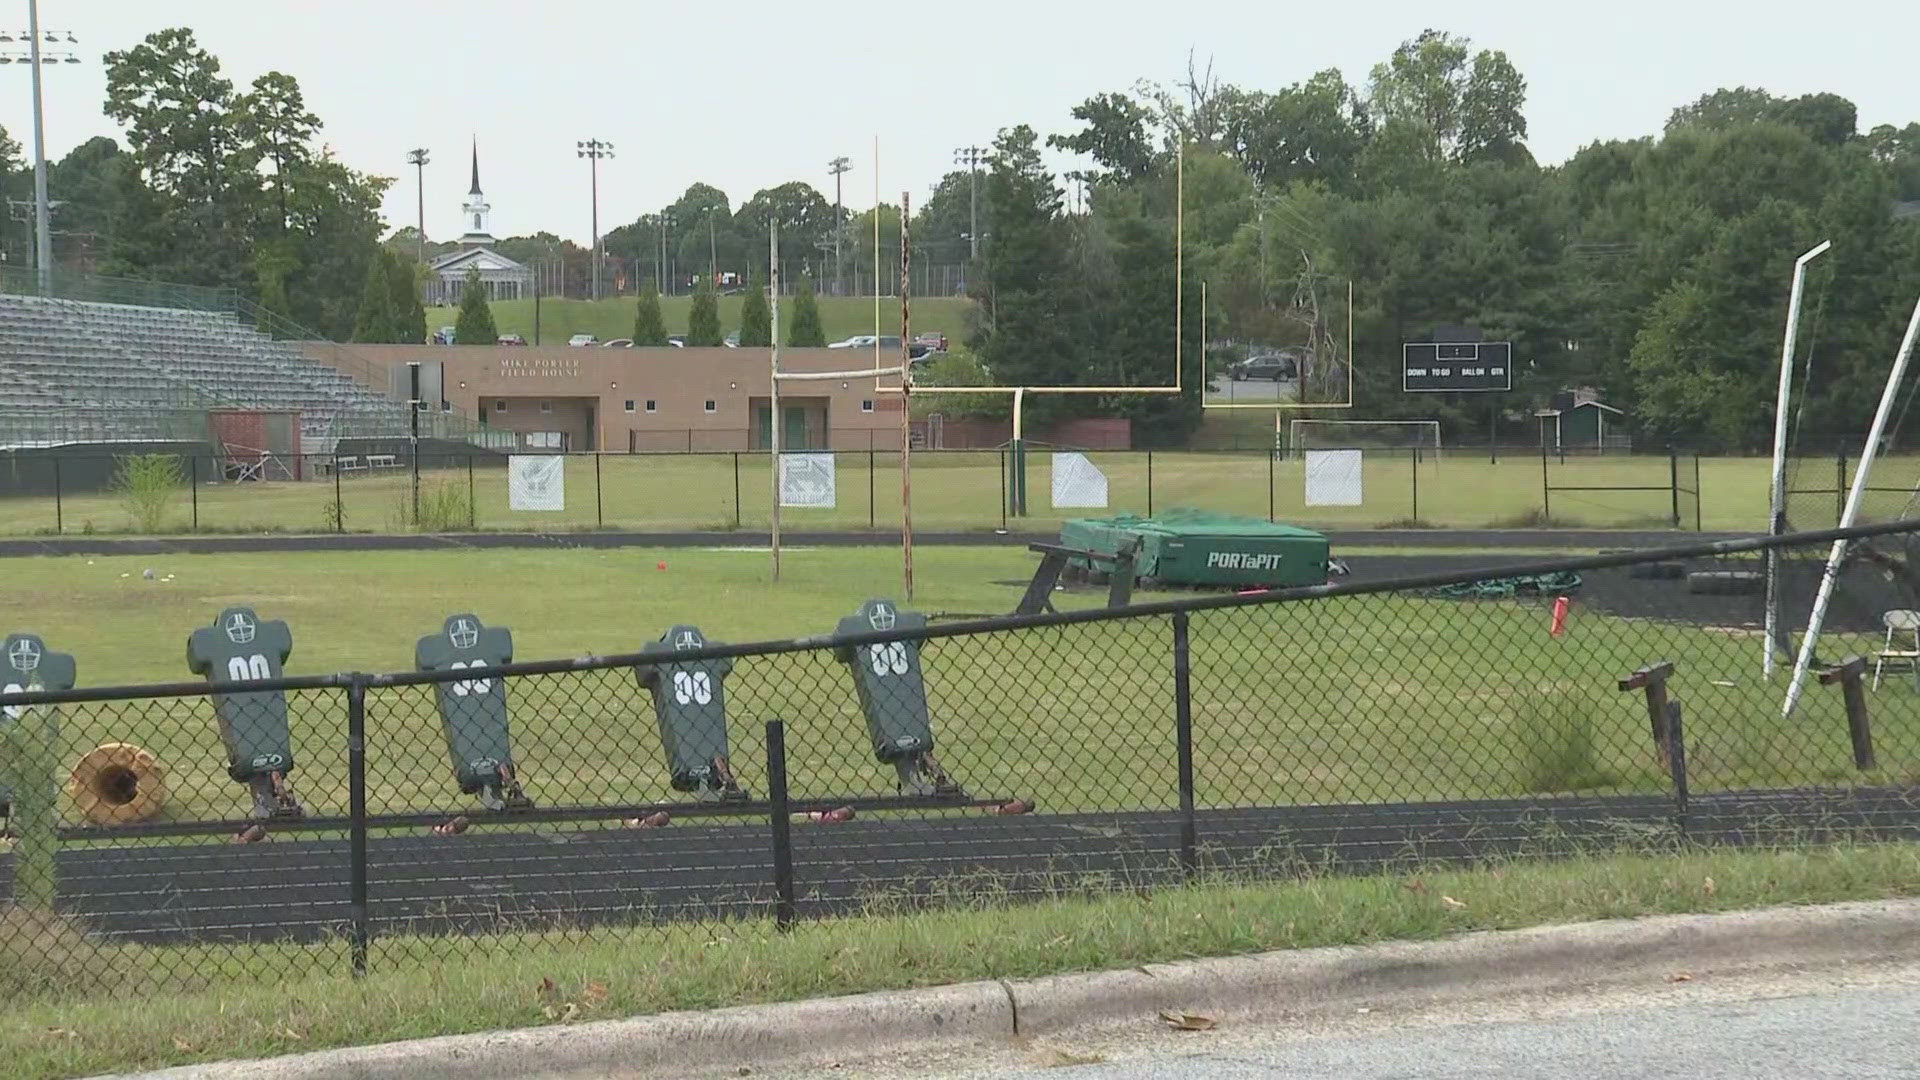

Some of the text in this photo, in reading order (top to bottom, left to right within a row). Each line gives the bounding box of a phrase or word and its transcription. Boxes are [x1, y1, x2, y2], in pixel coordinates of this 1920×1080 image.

[501, 359, 579, 367] MIKE PORTER
[501, 368, 578, 377] FIELD HOUSE
[1407, 368, 1427, 376] DOWN
[1432, 368, 1440, 376] TO
[1441, 368, 1451, 376] GO
[1462, 368, 1475, 376] BALL
[1476, 368, 1485, 376] ON
[1207, 551, 1282, 570] PORTaPIT
[870, 641, 909, 677] 00
